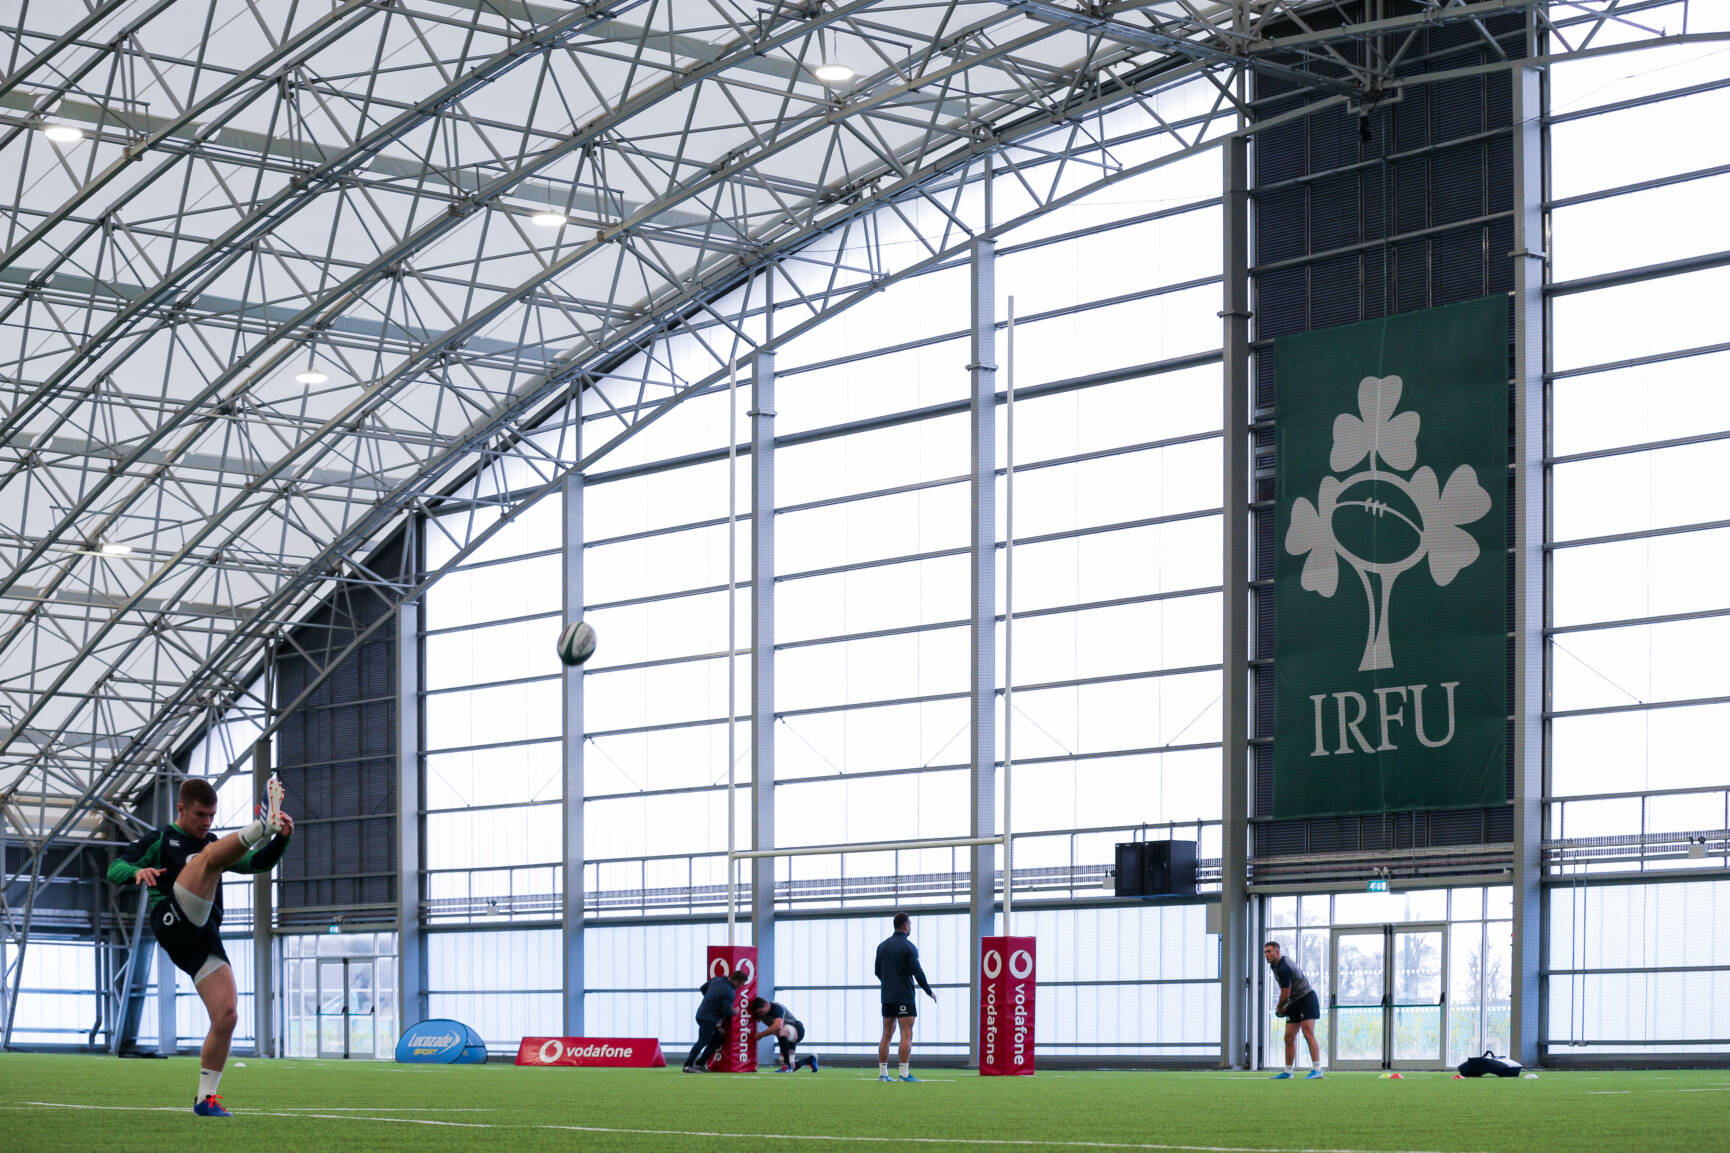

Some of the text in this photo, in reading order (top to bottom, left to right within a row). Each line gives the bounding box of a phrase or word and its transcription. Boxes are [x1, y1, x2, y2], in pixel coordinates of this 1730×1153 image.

[1309, 681, 1460, 757] IRFU
[566, 1044, 633, 1058] vodafone
[739, 988, 751, 1063] vodafone
[986, 983, 998, 1065] vodafone
[1013, 983, 1028, 1065] vodafone
